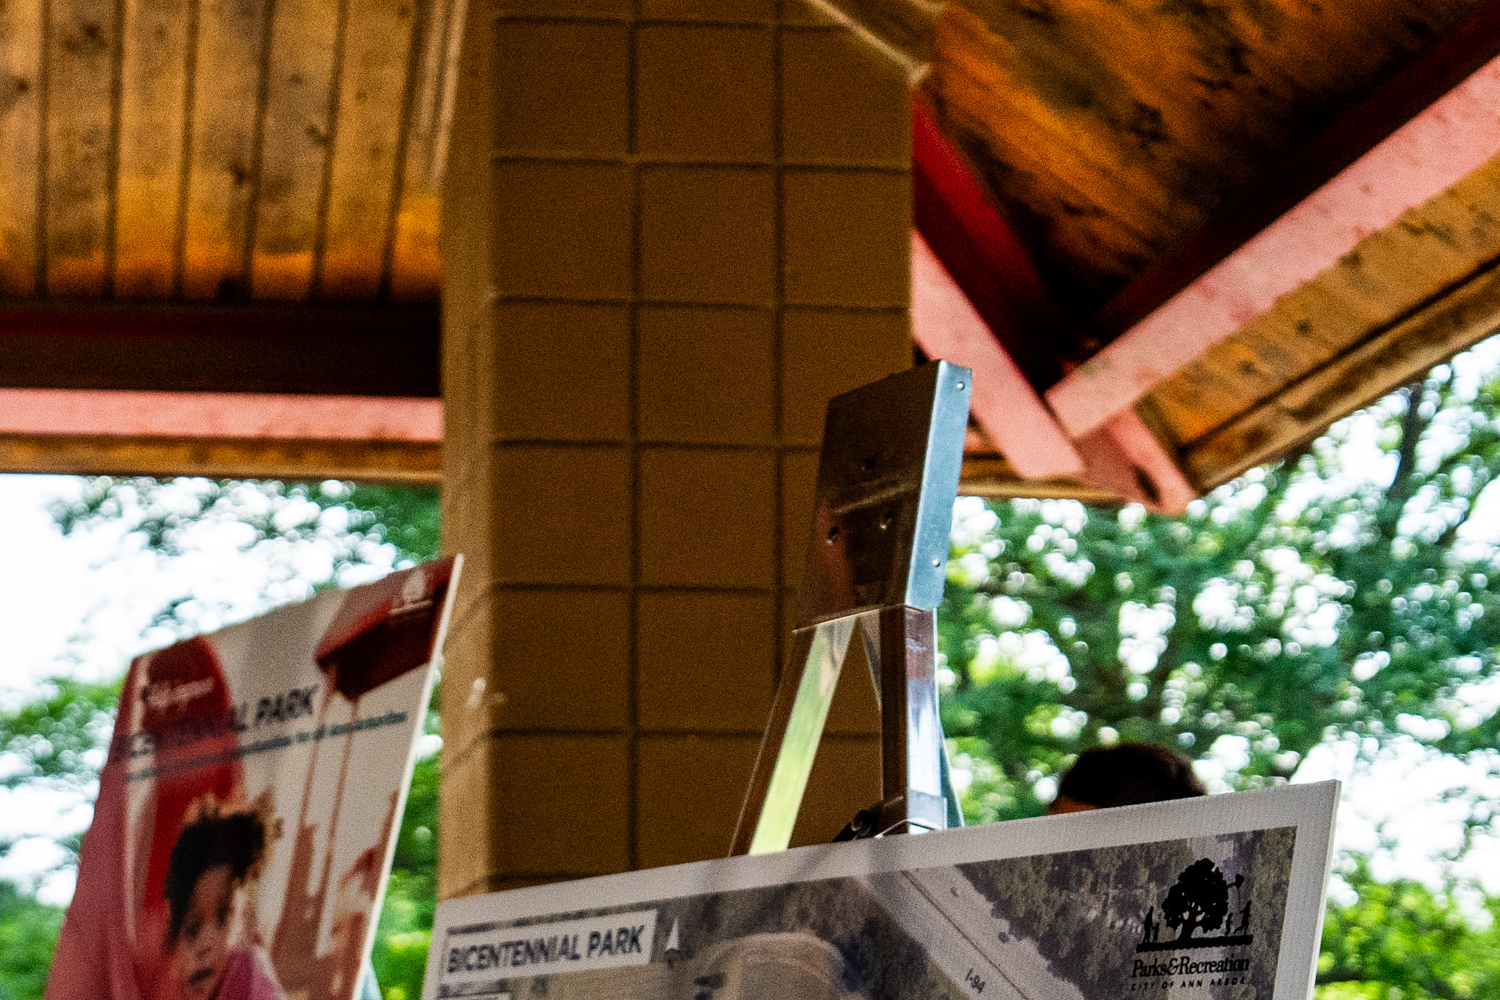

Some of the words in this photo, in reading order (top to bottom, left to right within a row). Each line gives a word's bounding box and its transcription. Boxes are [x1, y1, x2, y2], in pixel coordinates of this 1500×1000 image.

[447, 933, 581, 973] BICENTENNIAL
[586, 924, 645, 959] PARK
[1131, 982, 1156, 992] CITY
[1161, 980, 1175, 990] OF
[1180, 979, 1204, 989] ANN
[1209, 976, 1246, 986] ARBOR
